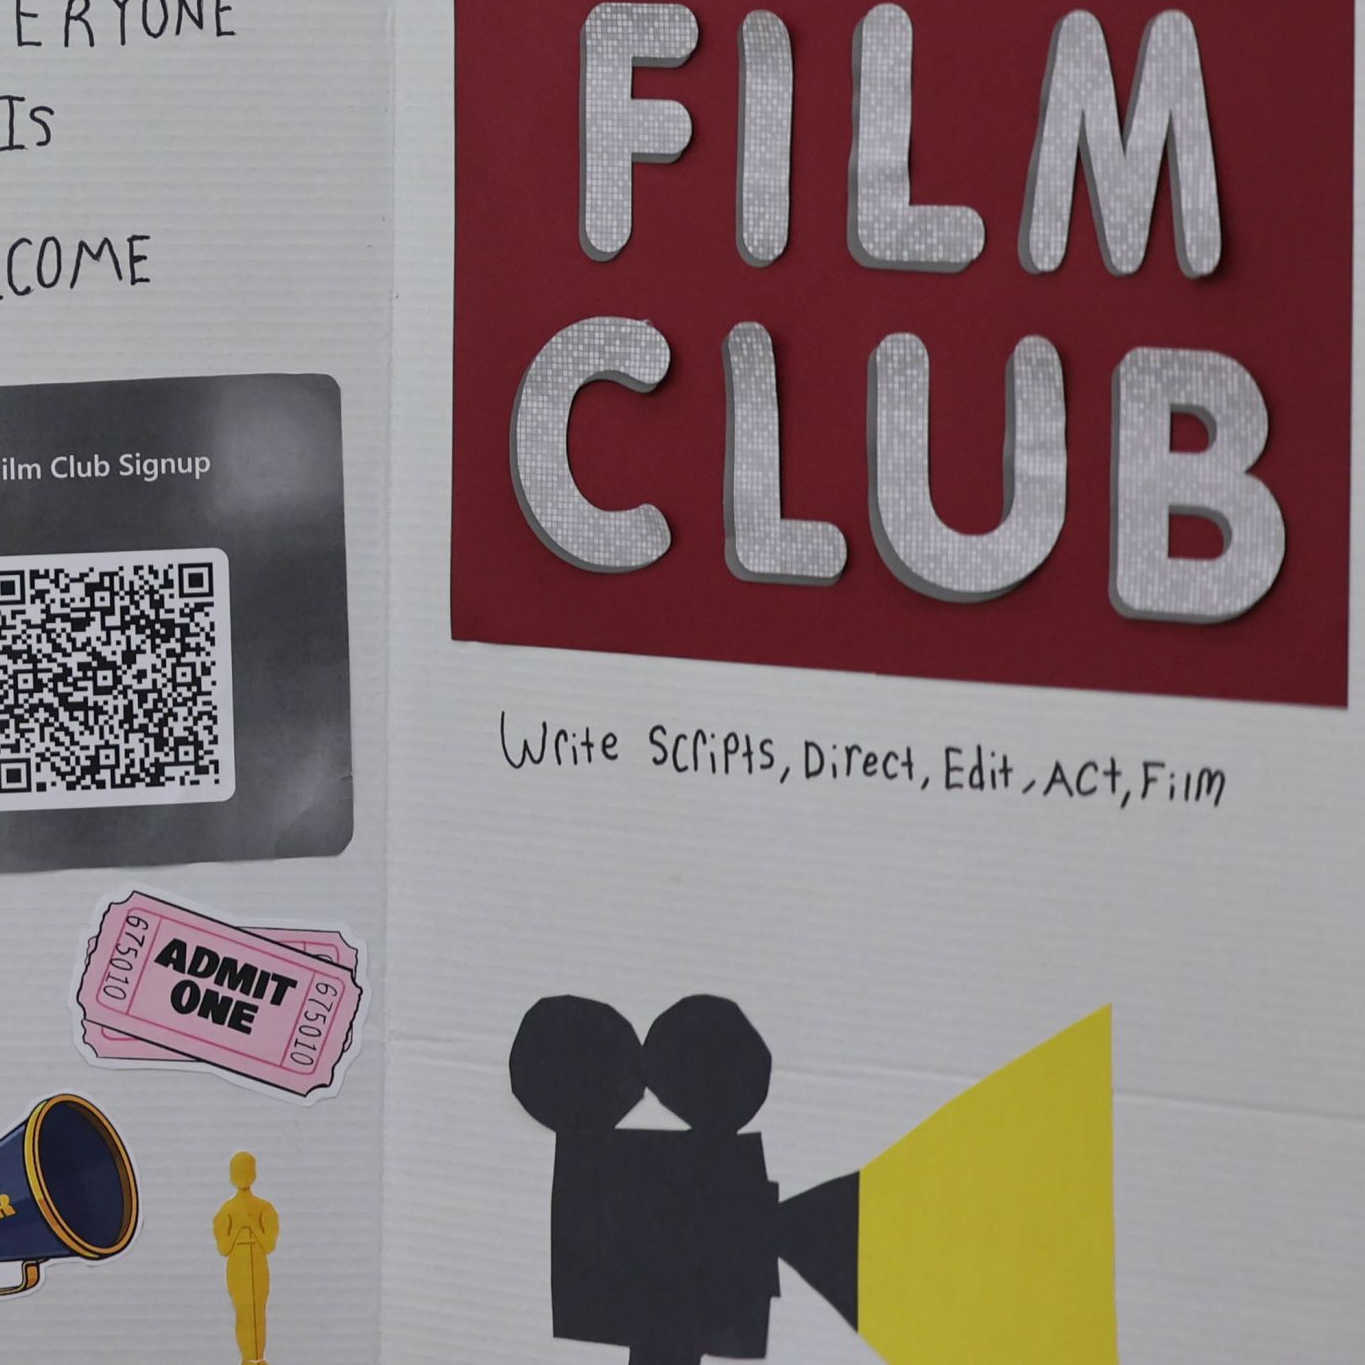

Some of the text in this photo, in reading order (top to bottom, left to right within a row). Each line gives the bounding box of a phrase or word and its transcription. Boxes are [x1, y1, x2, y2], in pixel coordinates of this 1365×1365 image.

[579, 1, 1222, 279] FILM
[50, 454, 110, 479] Club
[118, 452, 211, 480] Signup
[509, 315, 1286, 624] CLUB
[500, 710, 619, 770] Write
[103, 914, 150, 1002] 675010
[153, 938, 298, 1007] ADMIT
[170, 981, 260, 1035] ONE
[288, 980, 338, 1067] 675010
